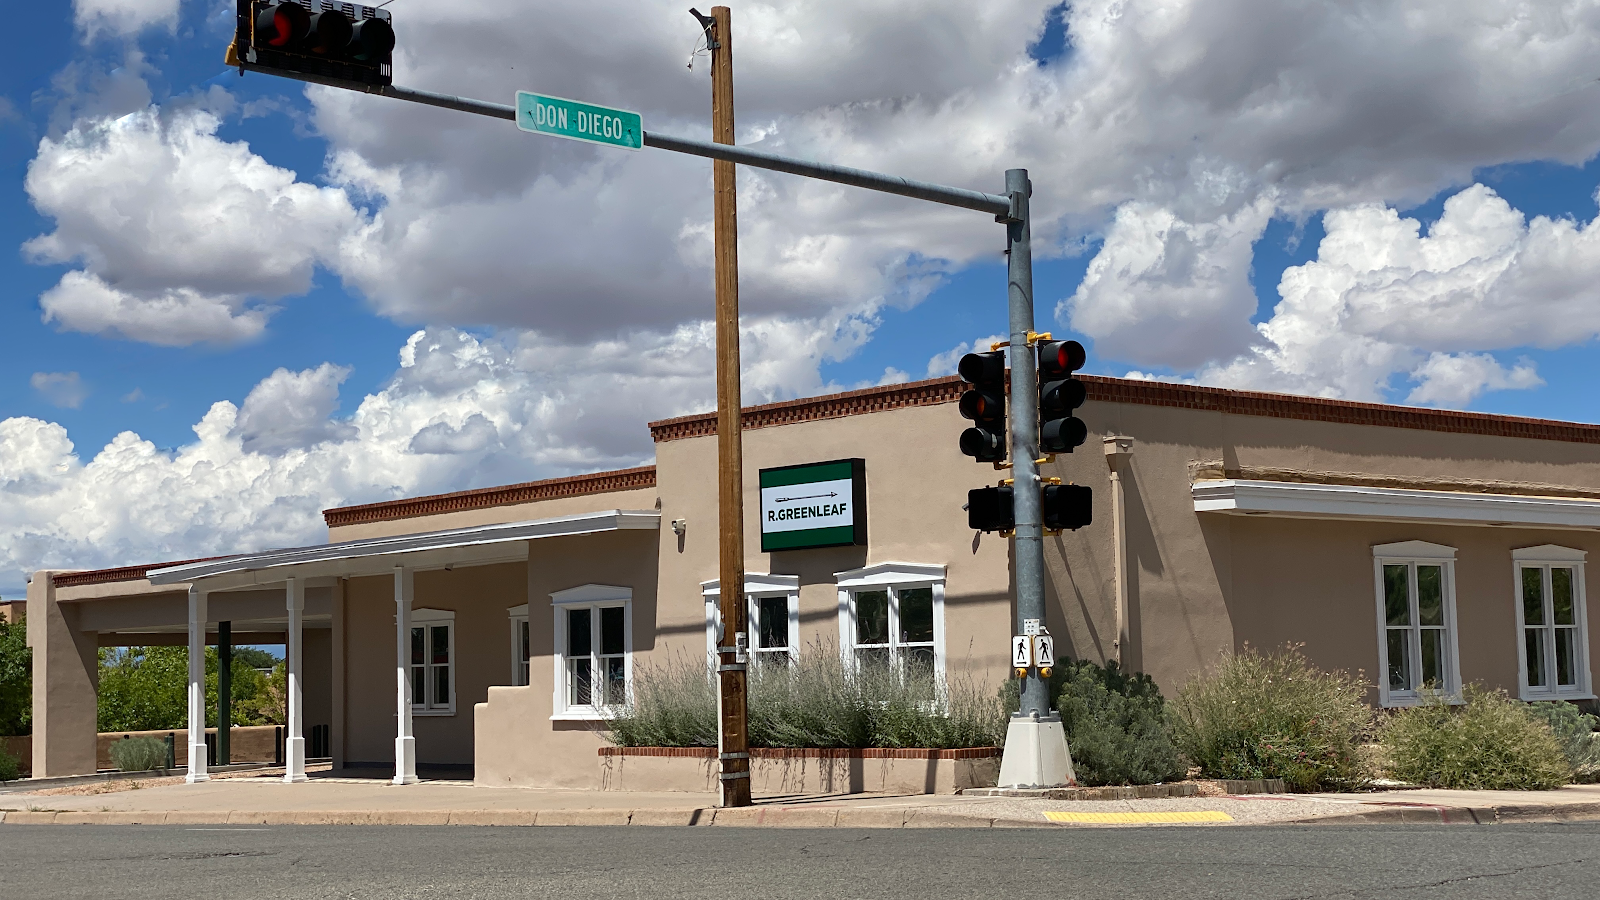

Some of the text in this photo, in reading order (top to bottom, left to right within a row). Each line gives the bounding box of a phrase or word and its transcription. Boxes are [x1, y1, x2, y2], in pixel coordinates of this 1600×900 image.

[536, 103, 623, 140] DON DIEGO
[768, 503, 847, 522] R.GREENLEAF
